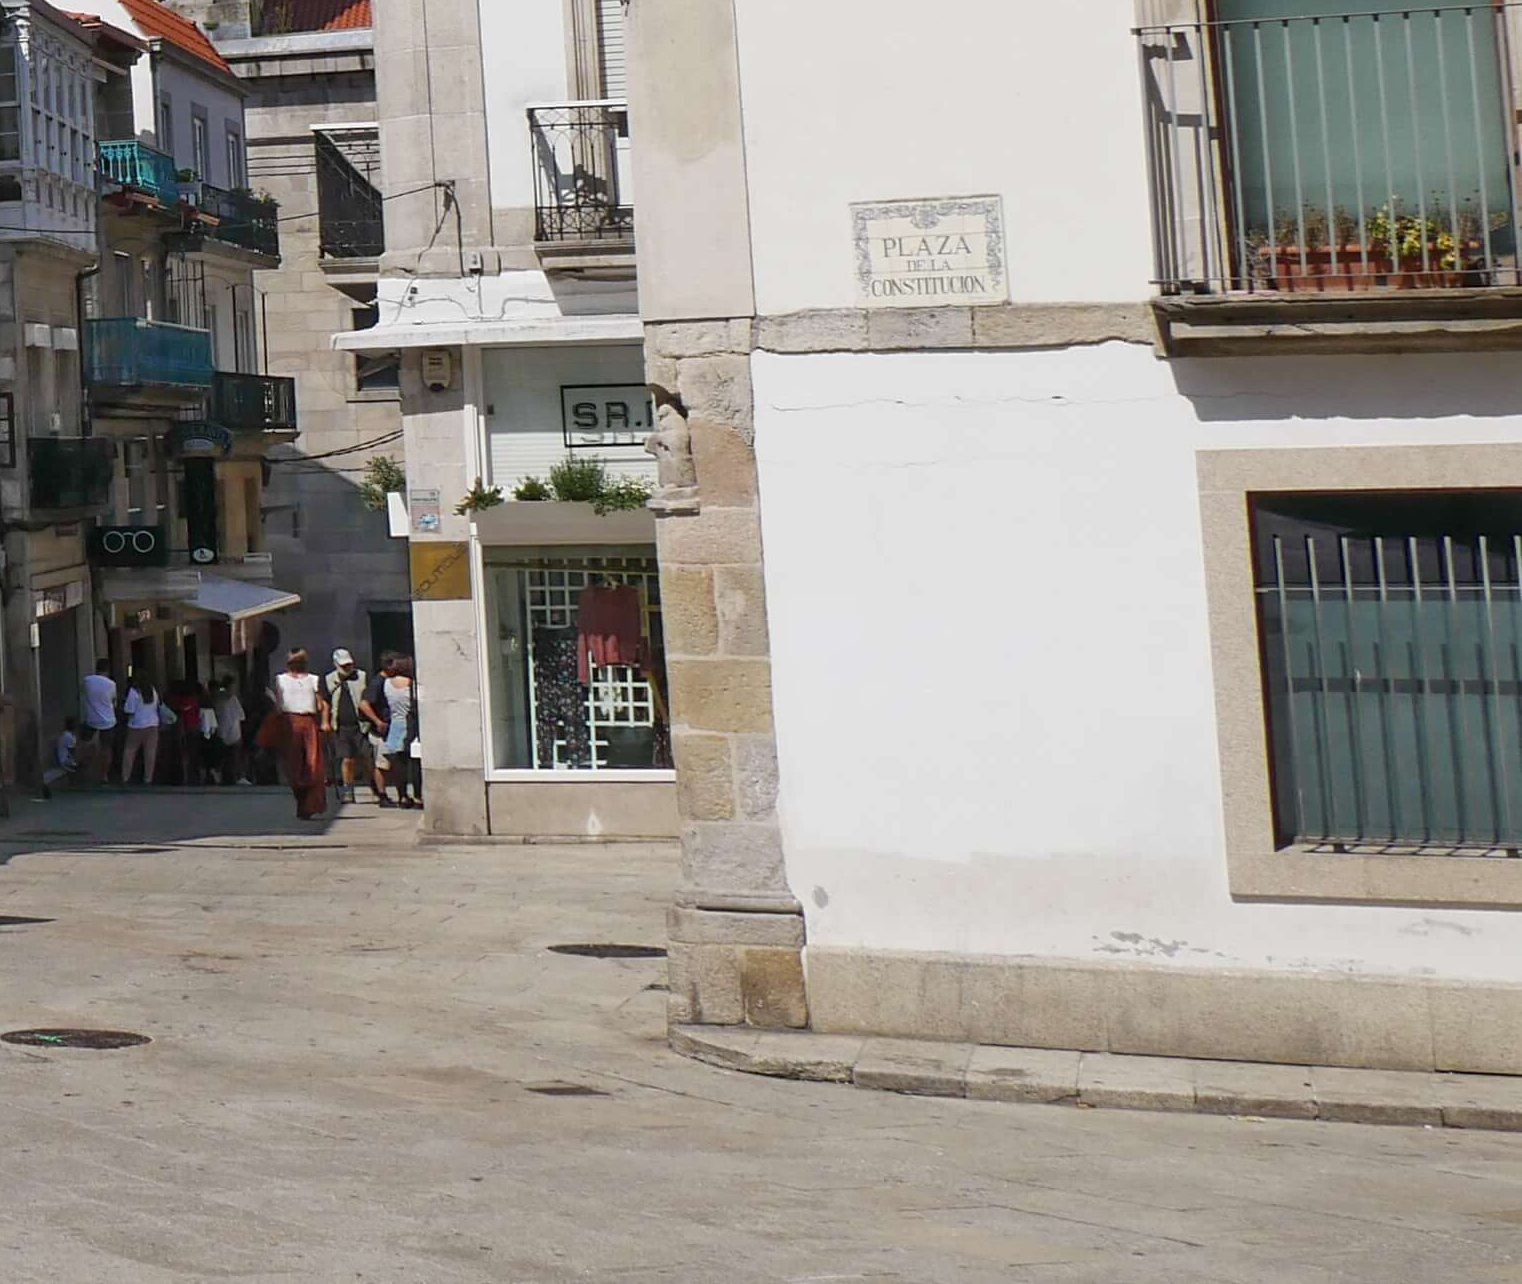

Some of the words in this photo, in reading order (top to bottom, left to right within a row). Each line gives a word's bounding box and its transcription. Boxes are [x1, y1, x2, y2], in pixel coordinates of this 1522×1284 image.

[882, 235, 972, 258] PLAZA
[907, 259, 925, 273] DE
[930, 259, 952, 272] LA
[871, 275, 986, 298] CONSTITUCION
